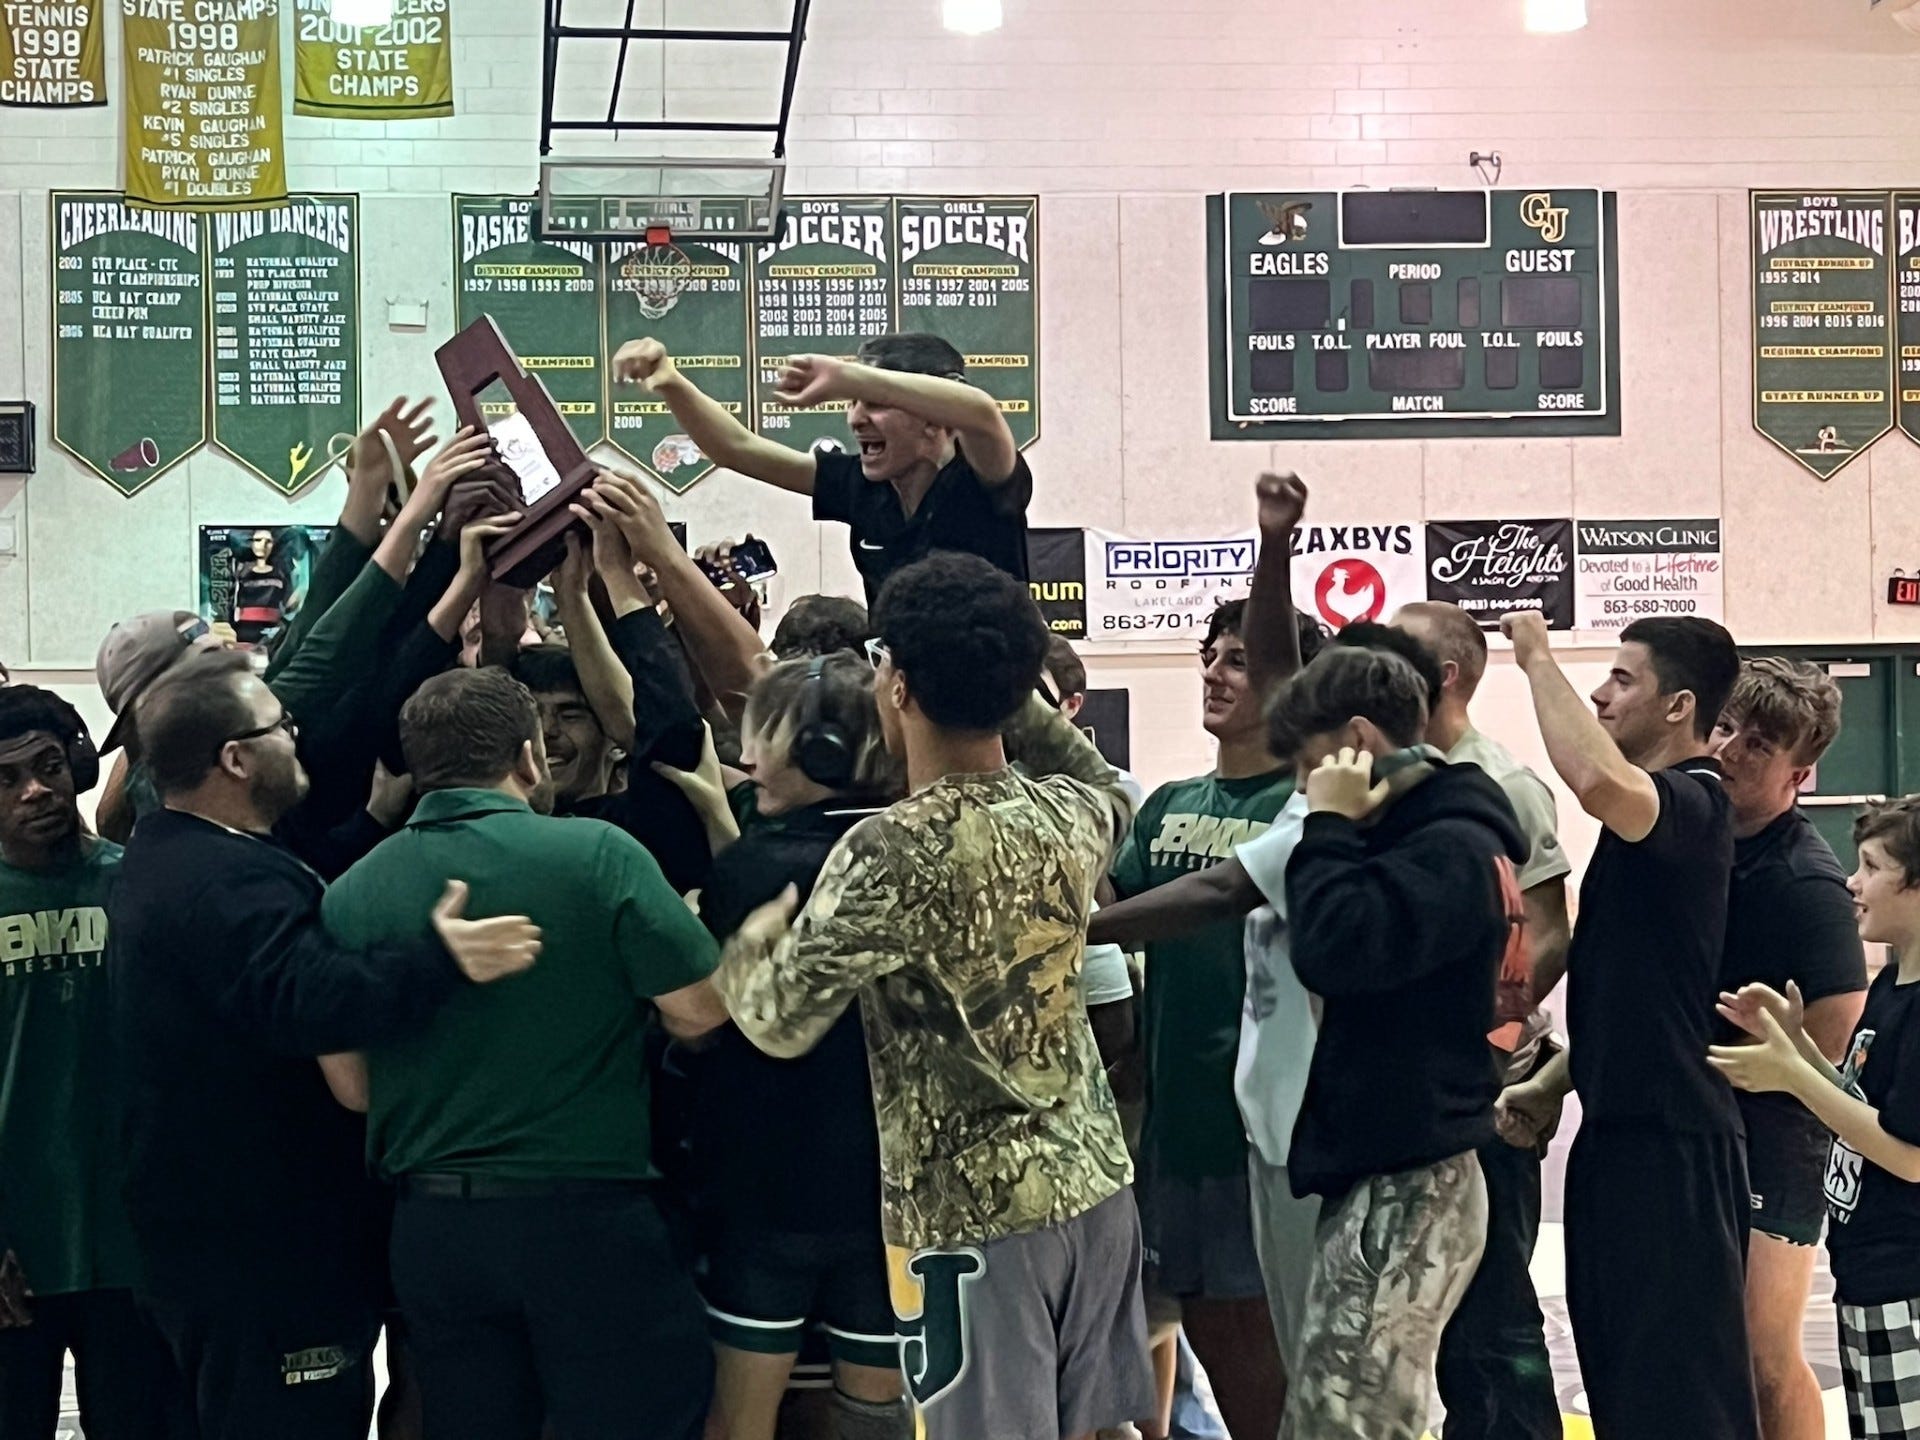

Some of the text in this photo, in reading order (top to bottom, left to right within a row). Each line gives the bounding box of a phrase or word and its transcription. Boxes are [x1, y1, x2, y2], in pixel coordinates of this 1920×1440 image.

[4, 4, 88, 27] TENNIS
[123, 0, 186, 22] STATE
[194, 0, 278, 22] CHAMPS
[12, 28, 80, 56] 1998
[167, 22, 238, 50] 1998
[138, 47, 266, 67] PATRICK GAUGHAN
[337, 48, 409, 71] STATE
[14, 57, 80, 79] STATE
[163, 67, 245, 82] #1 SINGLES
[1, 80, 94, 103] CHAMPS
[160, 83, 256, 100] RYAN DUNNE
[329, 74, 419, 97] CHAMPS
[162, 101, 250, 115] #2 SINGLES
[143, 115, 266, 133] KEVIN GAUGHAN
[189, 134, 250, 148] SINGLES
[141, 147, 271, 166] PATRICK GAUGHAN
[162, 165, 260, 181] RYAN DUNNE
[187, 182, 251, 196] DOUBLES
[508, 201, 532, 213] BO
[802, 202, 839, 213] BOYS
[944, 202, 985, 214] GIRLS
[1803, 197, 1838, 207] BOYS
[61, 202, 197, 254] CHEERLEADING
[215, 205, 349, 254] WIND DANCERS
[1759, 210, 1883, 256] WRESTLING
[902, 216, 1029, 264] SOCCER
[1250, 253, 1329, 275] EAGLES
[1506, 250, 1575, 272] GUEST
[1389, 264, 1441, 279] PERIOD
[1760, 271, 1821, 283] 1995 2014
[464, 279, 594, 291] 1997 1998 1999 2000
[711, 279, 740, 291] 2001
[759, 279, 887, 291] 1994 1995 1996 1997
[903, 279, 1029, 291] 1996 1997 2004 2005
[793, 294, 821, 307] 1999
[826, 294, 854, 306] 2000
[859, 293, 887, 306] 2001
[903, 294, 997, 306] 2006 2007 2011
[760, 308, 887, 322] 2002 2003 2004 2005
[1760, 315, 1788, 328] 1996
[1825, 315, 1853, 328] 2015
[1857, 315, 1884, 327] 2016
[826, 323, 855, 336] 2012
[859, 322, 888, 336] 2017
[1249, 335, 1295, 350] FOULS
[1312, 335, 1352, 350] T.O.L.
[1366, 333, 1466, 349] PLAYER FOUL
[1481, 332, 1520, 348] T.O.L.
[1536, 331, 1584, 347] FOULS
[1818, 347, 1881, 355] CHAMPIONS
[526, 358, 592, 366] CHAMPIONS
[964, 356, 1026, 365] HAMPIONS
[1392, 396, 1443, 411] MATCH
[1538, 394, 1584, 409] SCORE
[1765, 392, 1802, 400] STATE
[1807, 392, 1860, 400] RUNNER
[1250, 397, 1296, 413] SCORE
[614, 416, 642, 428] 2000
[762, 416, 790, 428] 2005
[1291, 525, 1412, 557] ZAXBYS
[1494, 523, 1539, 553] The
[1113, 545, 1247, 570] PRIORITY
[1431, 536, 1568, 588] Heights
[1579, 558, 1628, 573] Devoted
[1632, 561, 1643, 573] to
[1655, 552, 1720, 579] Lifetime
[1601, 575, 1697, 591] of Good Health
[1029, 582, 1084, 601] num
[1134, 596, 1203, 608] LAKELAND
[1604, 599, 1696, 613] 863-680-7000
